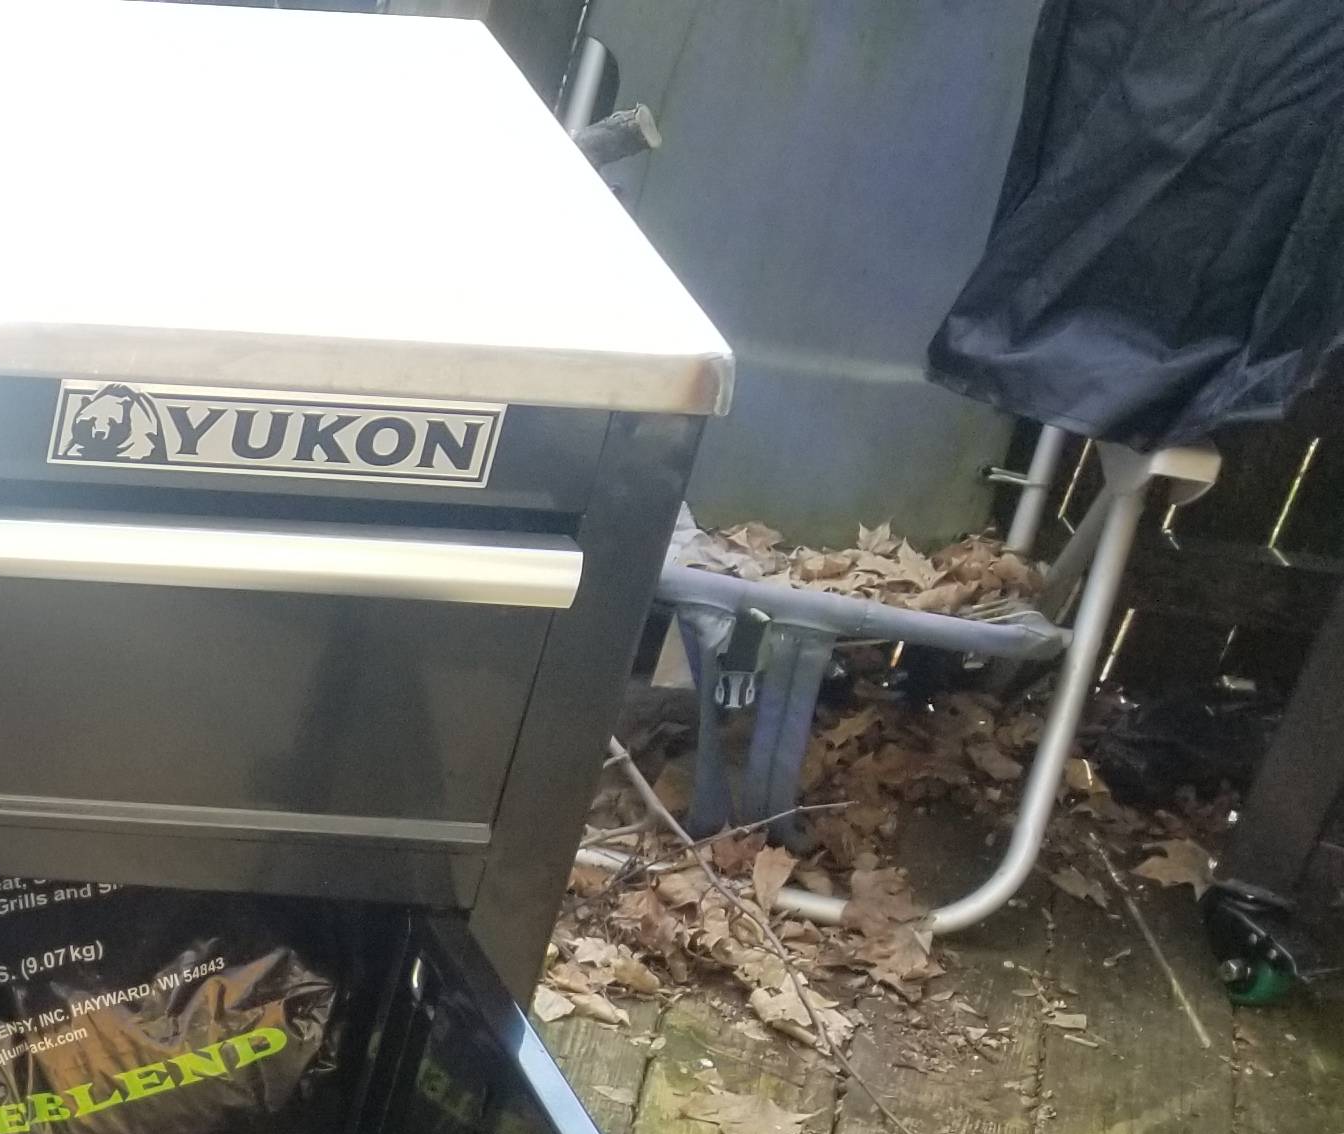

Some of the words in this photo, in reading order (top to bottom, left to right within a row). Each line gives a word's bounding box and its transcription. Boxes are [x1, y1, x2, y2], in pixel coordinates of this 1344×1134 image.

[165, 405, 485, 472] YUKON
[54, 883, 92, 901] and
[21, 947, 67, 980] (9.07
[69, 940, 103, 963] kg)
[39, 1009, 69, 1027] INC.
[71, 983, 157, 1018] HAYWARD,
[157, 973, 181, 991] WI
[183, 958, 226, 983] 54843
